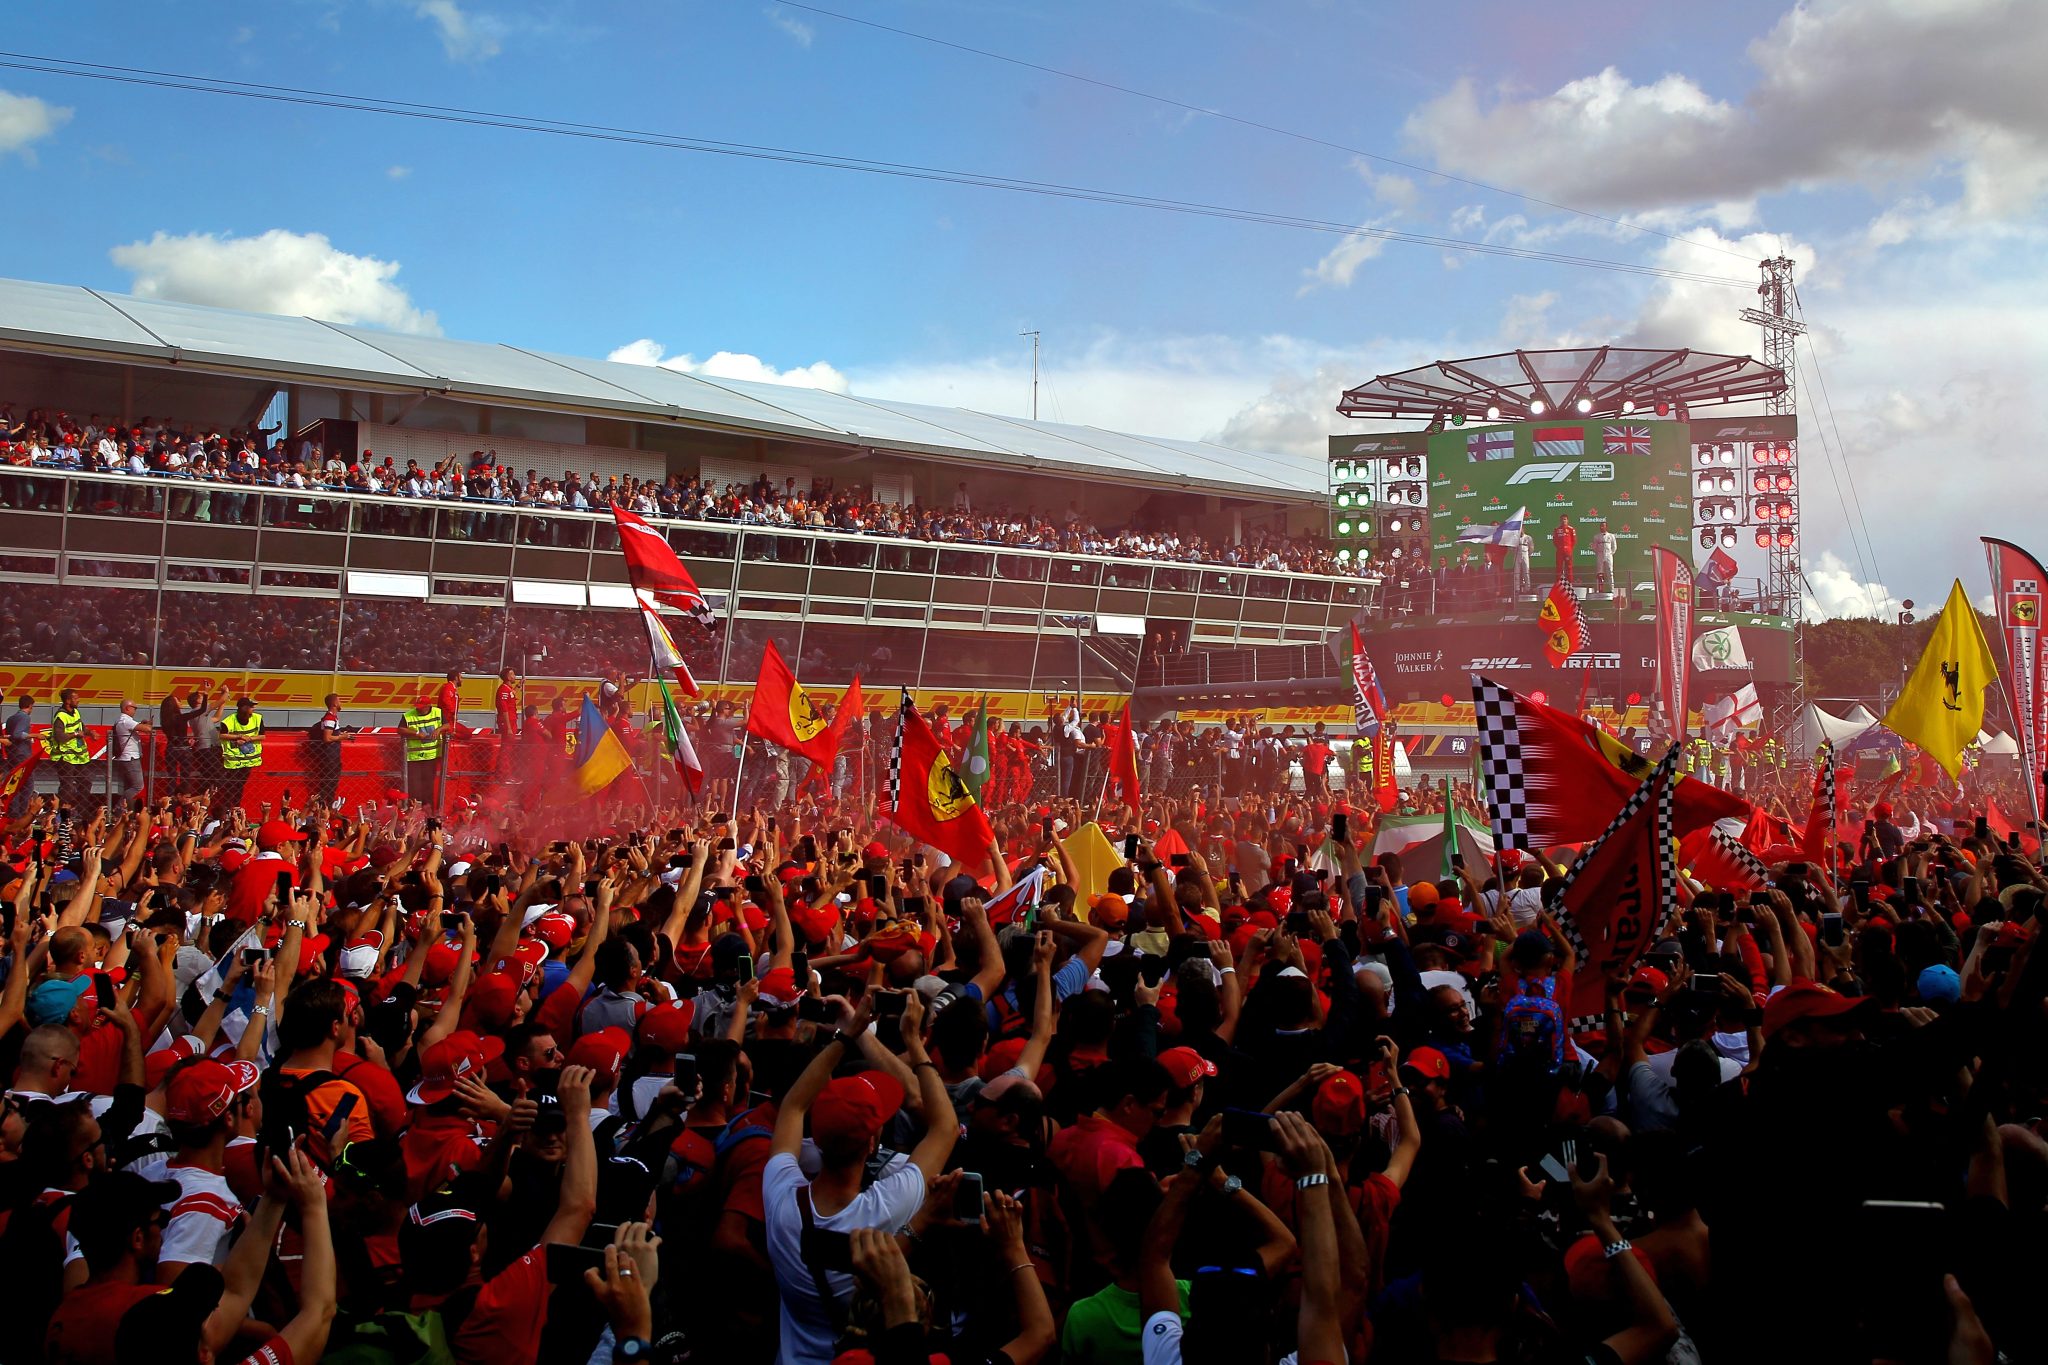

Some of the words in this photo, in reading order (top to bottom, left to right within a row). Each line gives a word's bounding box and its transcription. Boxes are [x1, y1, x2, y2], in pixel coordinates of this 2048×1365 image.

[1504, 462, 1580, 485] F1
[1394, 652, 1431, 664] JOHNNIE
[1470, 658, 1522, 670] DHL
[1396, 663, 1432, 672] WALKER
[168, 676, 291, 702] DHL
[1452, 740, 1466, 751] FIA
